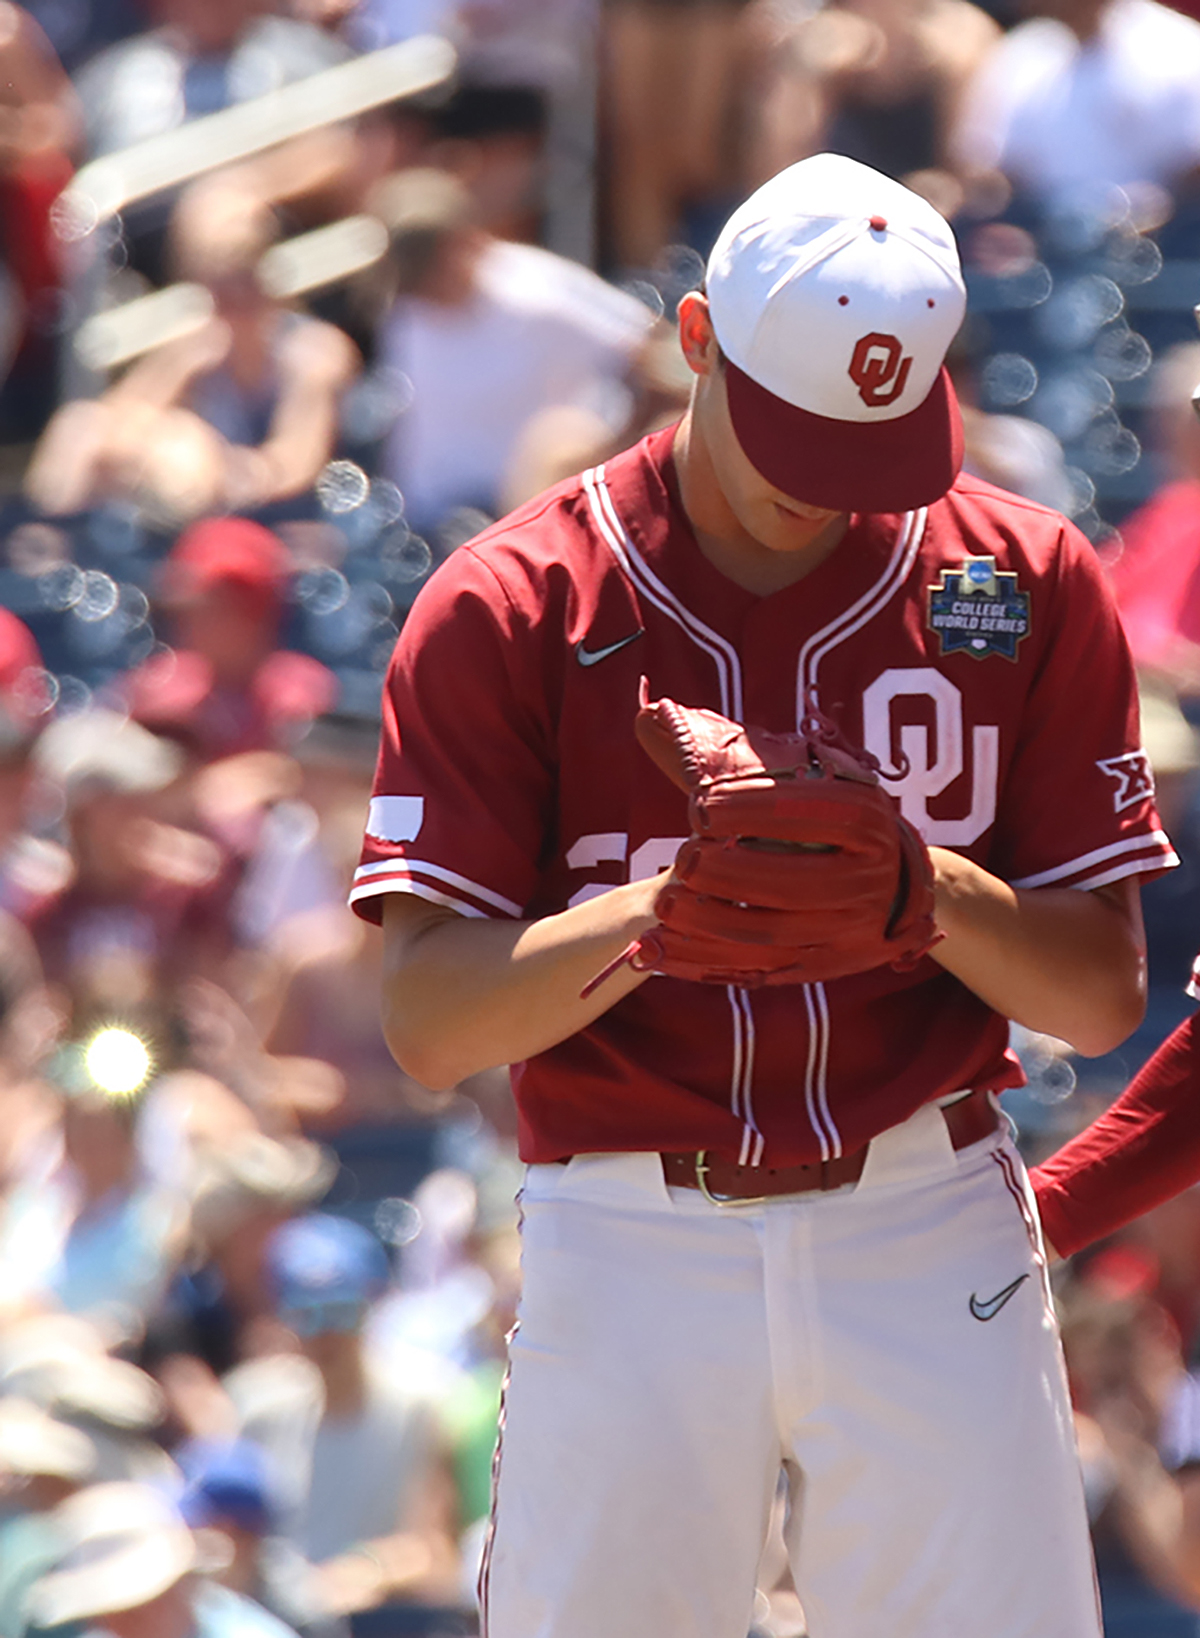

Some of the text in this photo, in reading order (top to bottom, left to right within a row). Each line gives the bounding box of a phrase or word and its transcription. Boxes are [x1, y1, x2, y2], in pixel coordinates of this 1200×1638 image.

[848, 331, 913, 407] OU
[932, 614, 1027, 634] WORLD SERIES
[951, 601, 1007, 618] COLLEGE
[863, 667, 998, 847] OU
